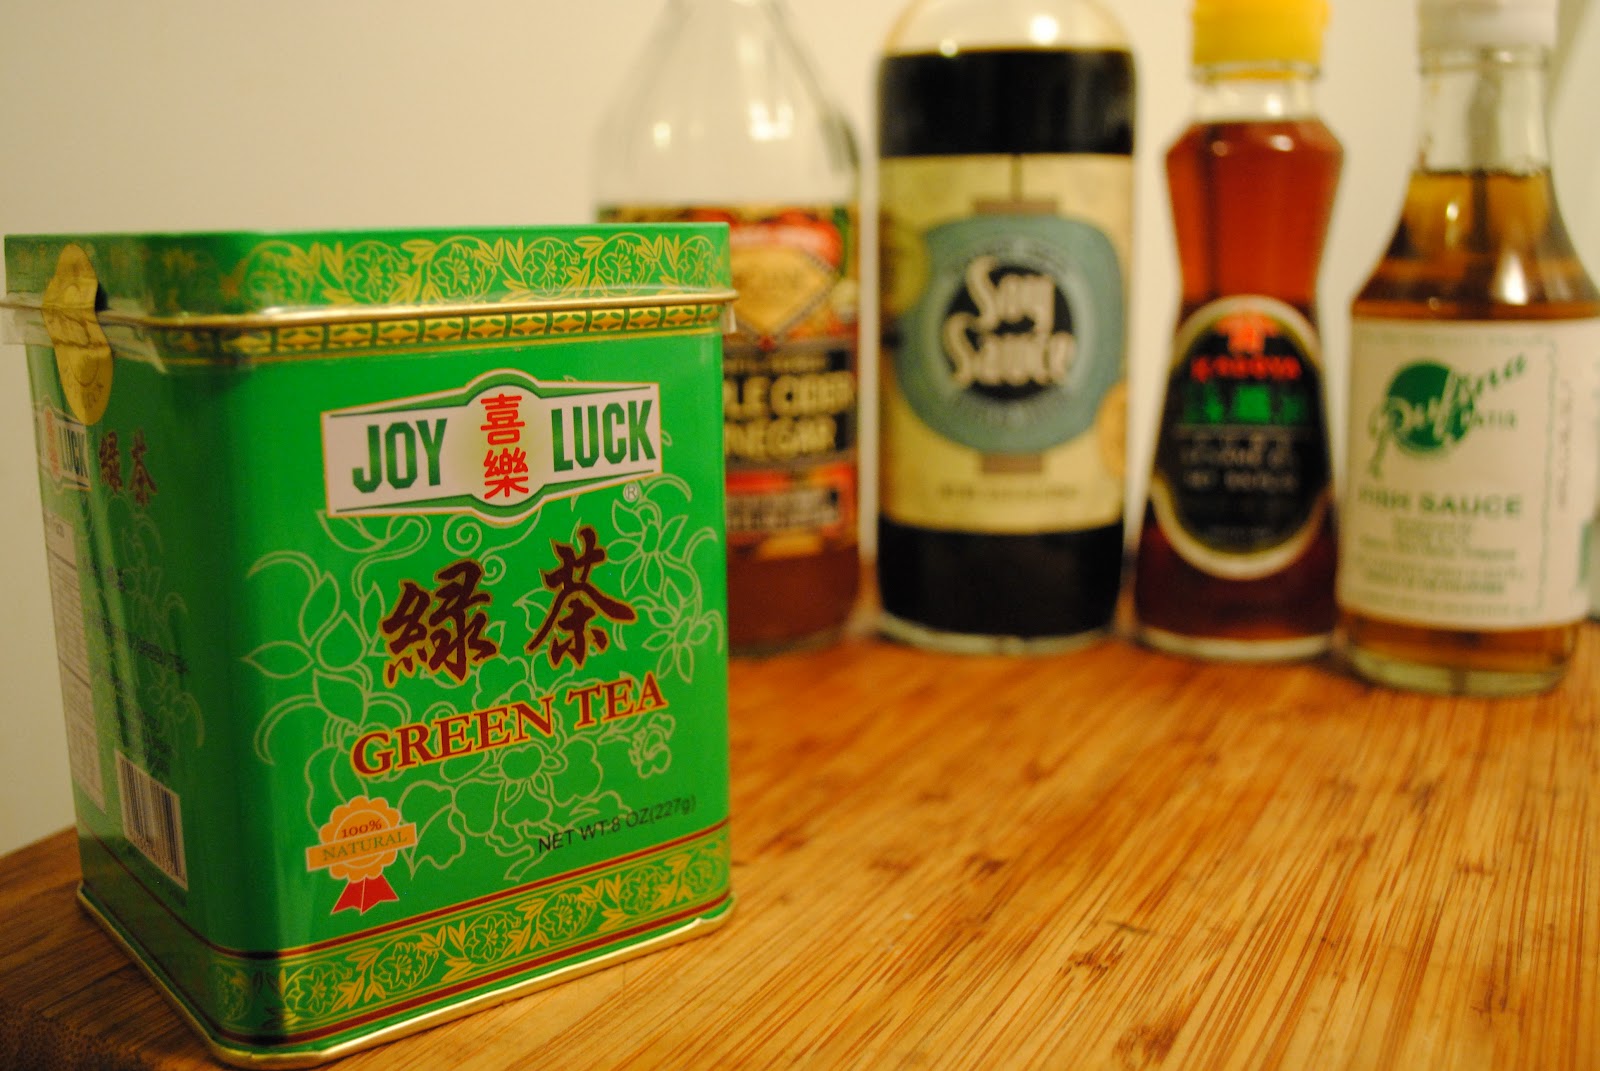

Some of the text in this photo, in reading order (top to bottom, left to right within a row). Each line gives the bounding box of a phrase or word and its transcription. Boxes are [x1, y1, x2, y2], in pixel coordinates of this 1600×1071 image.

[966, 256, 1056, 337] Soy
[942, 311, 1077, 390] Sauce
[352, 417, 448, 494] JOY
[550, 399, 657, 473] LUCK
[1418, 490, 1523, 517] SAUCE
[350, 672, 669, 777] GREEN TEA
[322, 831, 408, 862] NATURAL
[341, 819, 382, 839] 100%
[538, 828, 575, 854] NET
